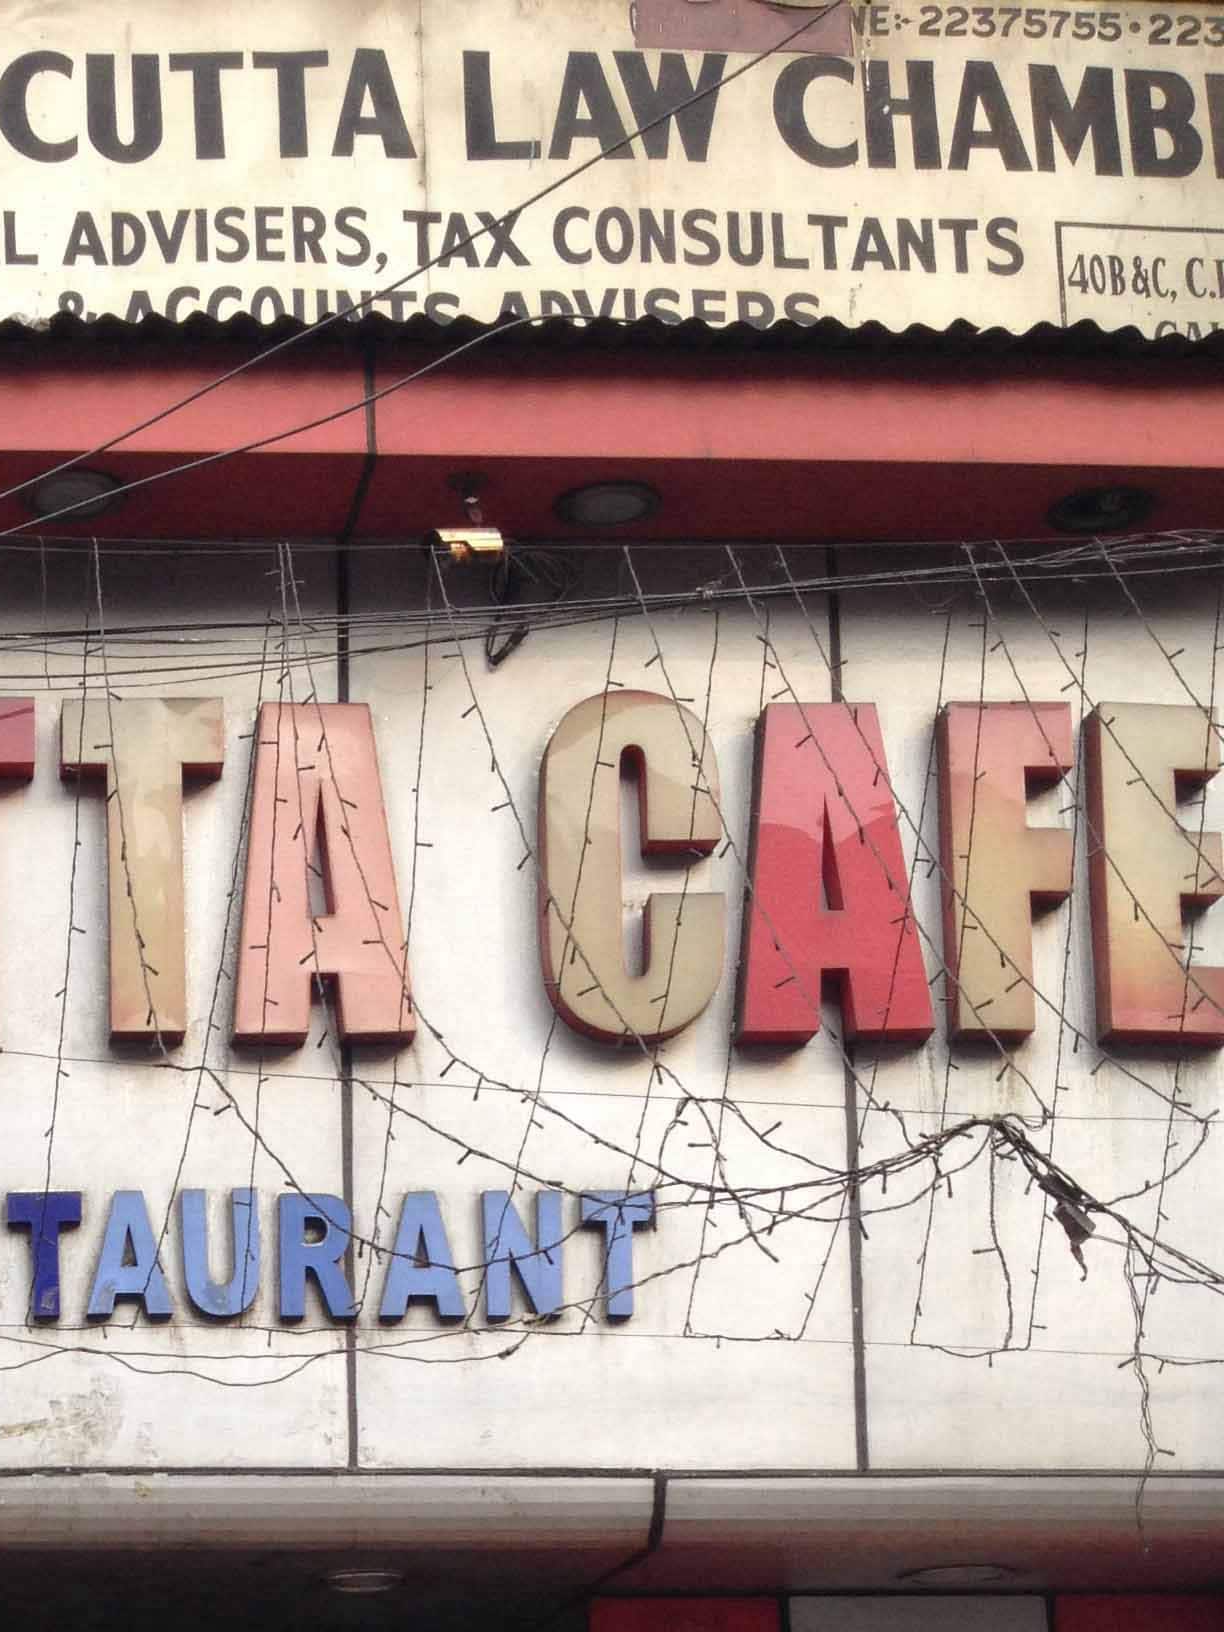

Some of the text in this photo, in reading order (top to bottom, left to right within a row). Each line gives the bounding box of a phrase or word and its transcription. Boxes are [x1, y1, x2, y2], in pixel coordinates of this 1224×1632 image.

[919, 6, 1122, 42] 22375755
[462, 49, 727, 163] LAW
[773, 55, 1224, 180] CHAMB
[62, 207, 388, 274] ADVISERS,
[402, 209, 531, 268] TAX
[552, 206, 1025, 277] CONSULTANTS
[536, 689, 1224, 1050] CAFE
